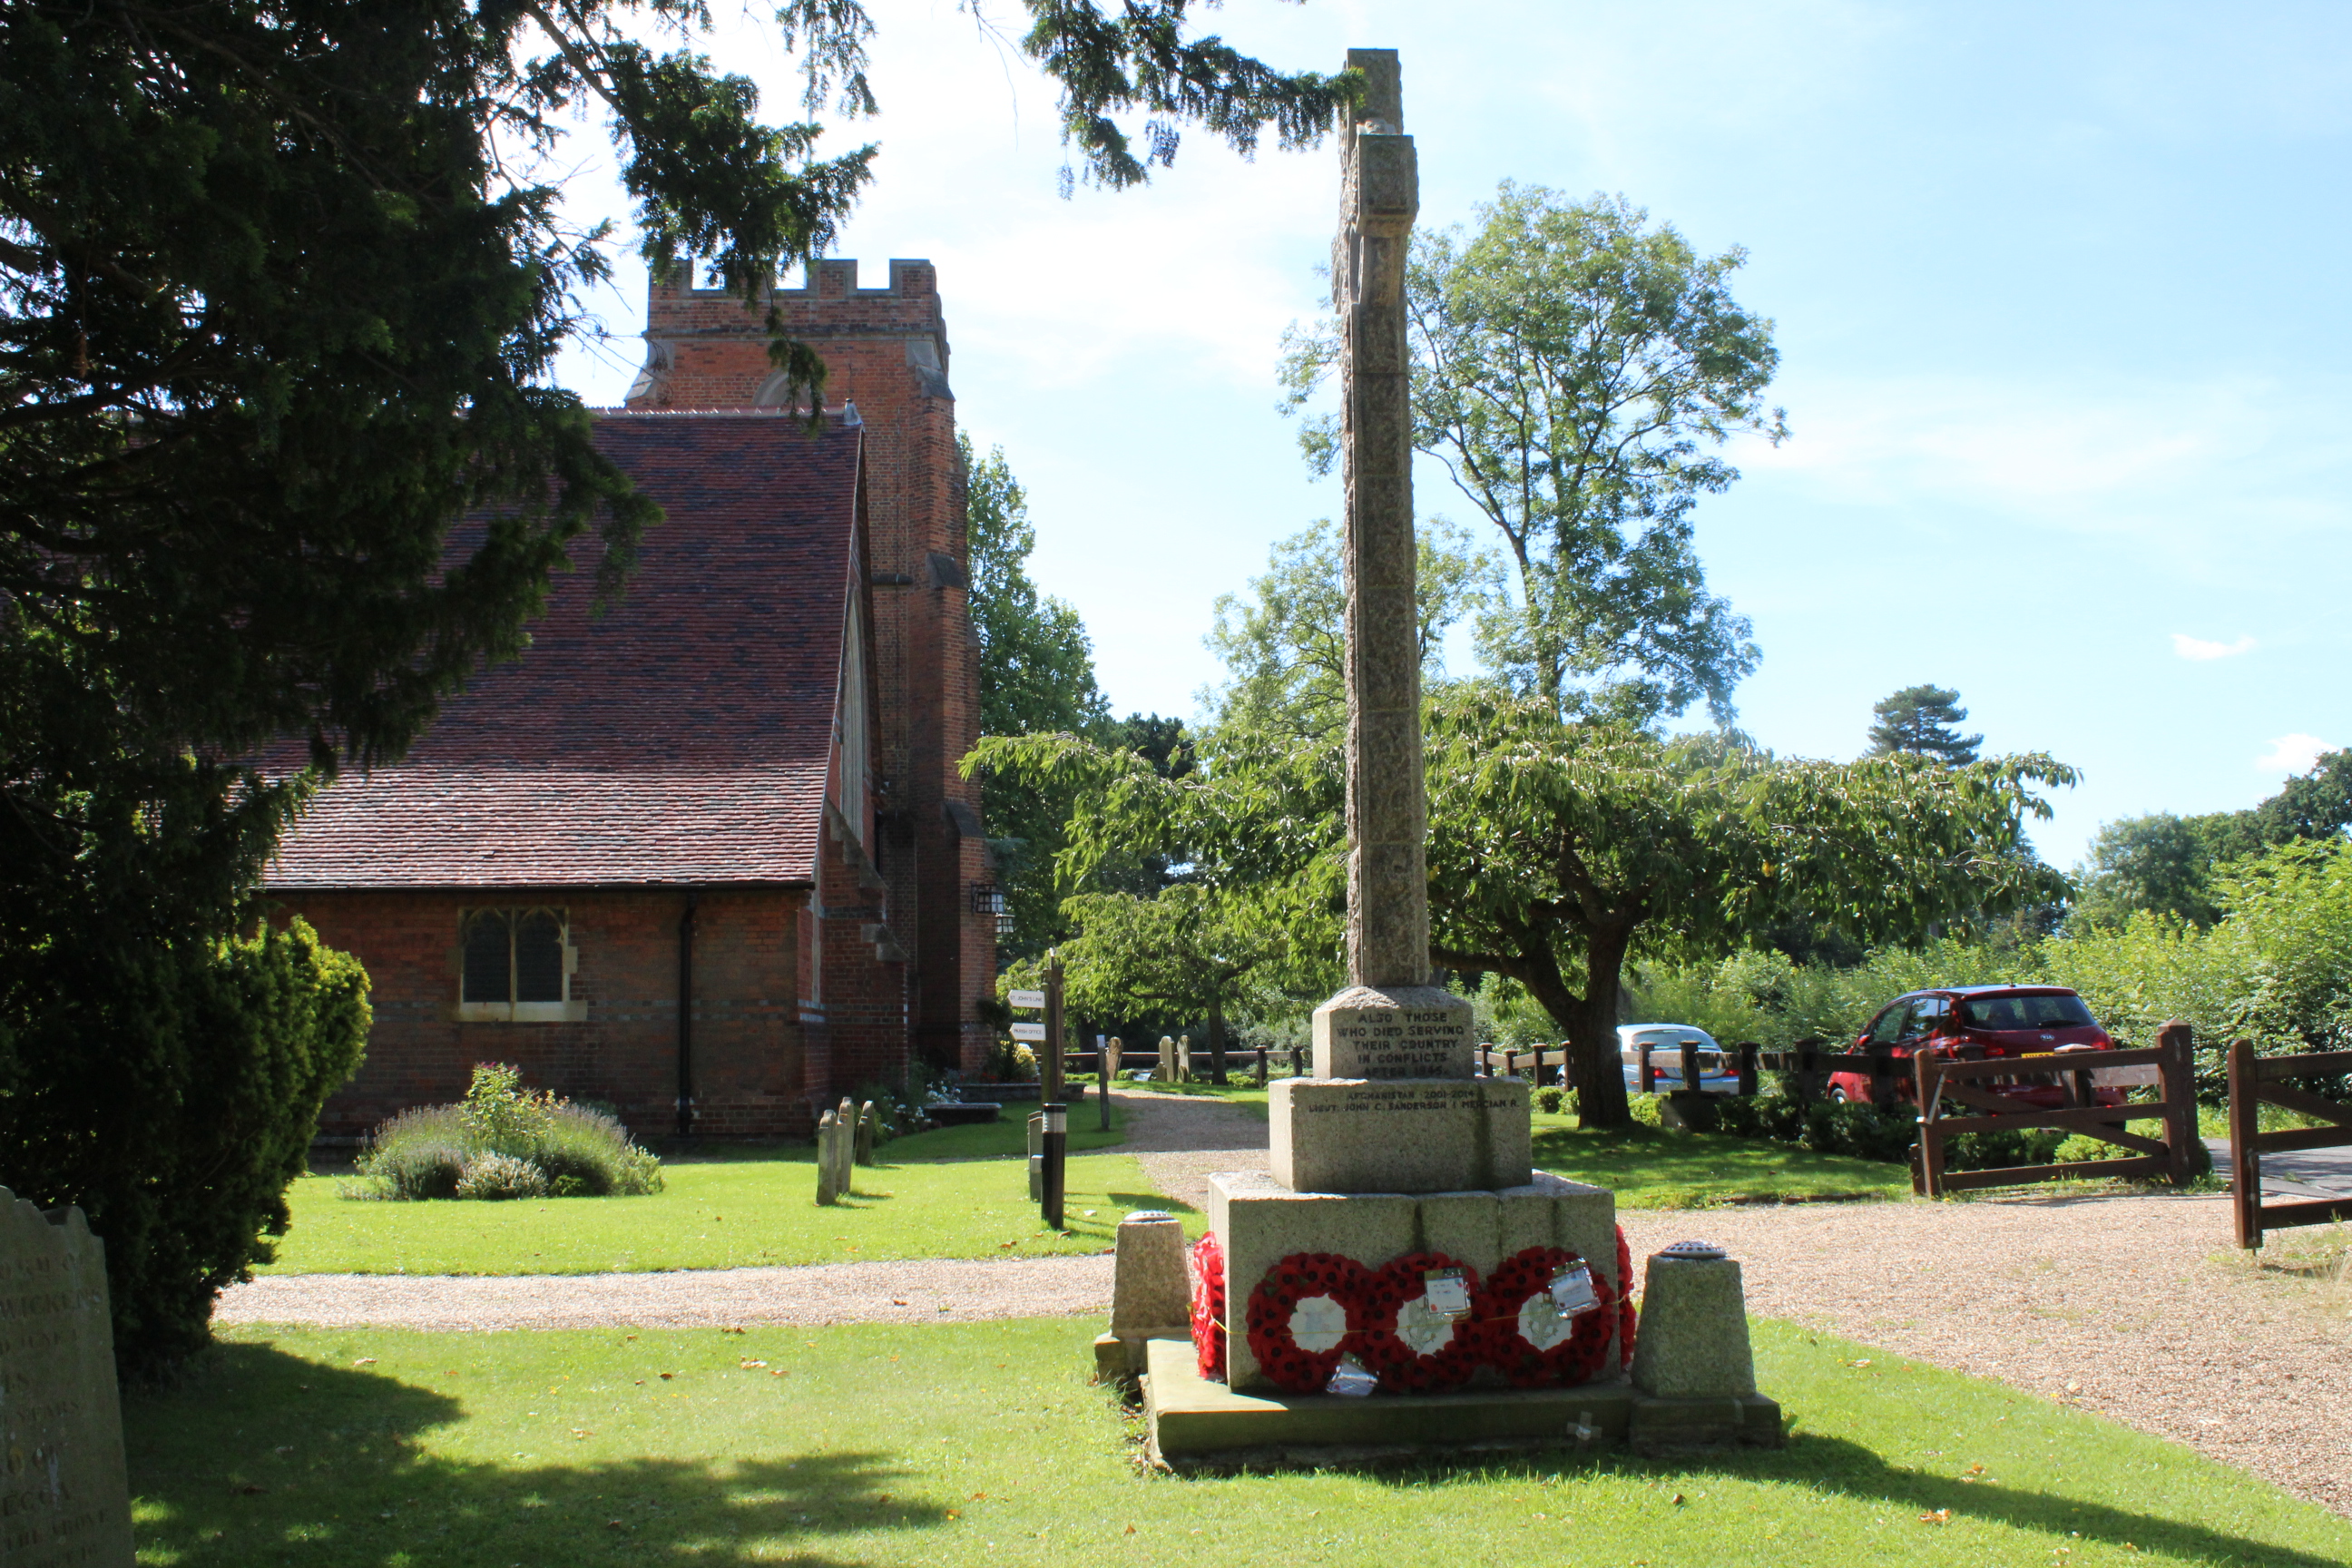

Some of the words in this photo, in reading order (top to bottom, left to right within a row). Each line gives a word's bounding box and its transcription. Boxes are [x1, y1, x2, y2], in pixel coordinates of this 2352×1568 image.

[1357, 1013, 1393, 1024] ALSO
[1406, 1012, 1447, 1023] THOSE
[1337, 1027, 1367, 1037] WHO
[1373, 1026, 1403, 1037] DIED
[1408, 1025, 1465, 1036] SERVING
[1353, 1040, 1390, 1051] THEIR
[1400, 1039, 1458, 1050] COUNTRY
[1357, 1054, 1370, 1064] IN
[1377, 1053, 1447, 1063] CONFLICTS
[1363, 1066, 1406, 1077] AFTER
[1348, 1092, 1415, 1100] AFGHANISTAN
[1344, 1102, 1369, 1112] JOHN
[1388, 1102, 1446, 1111] SANDERSON
[1462, 1100, 1506, 1109] MERCIAN
